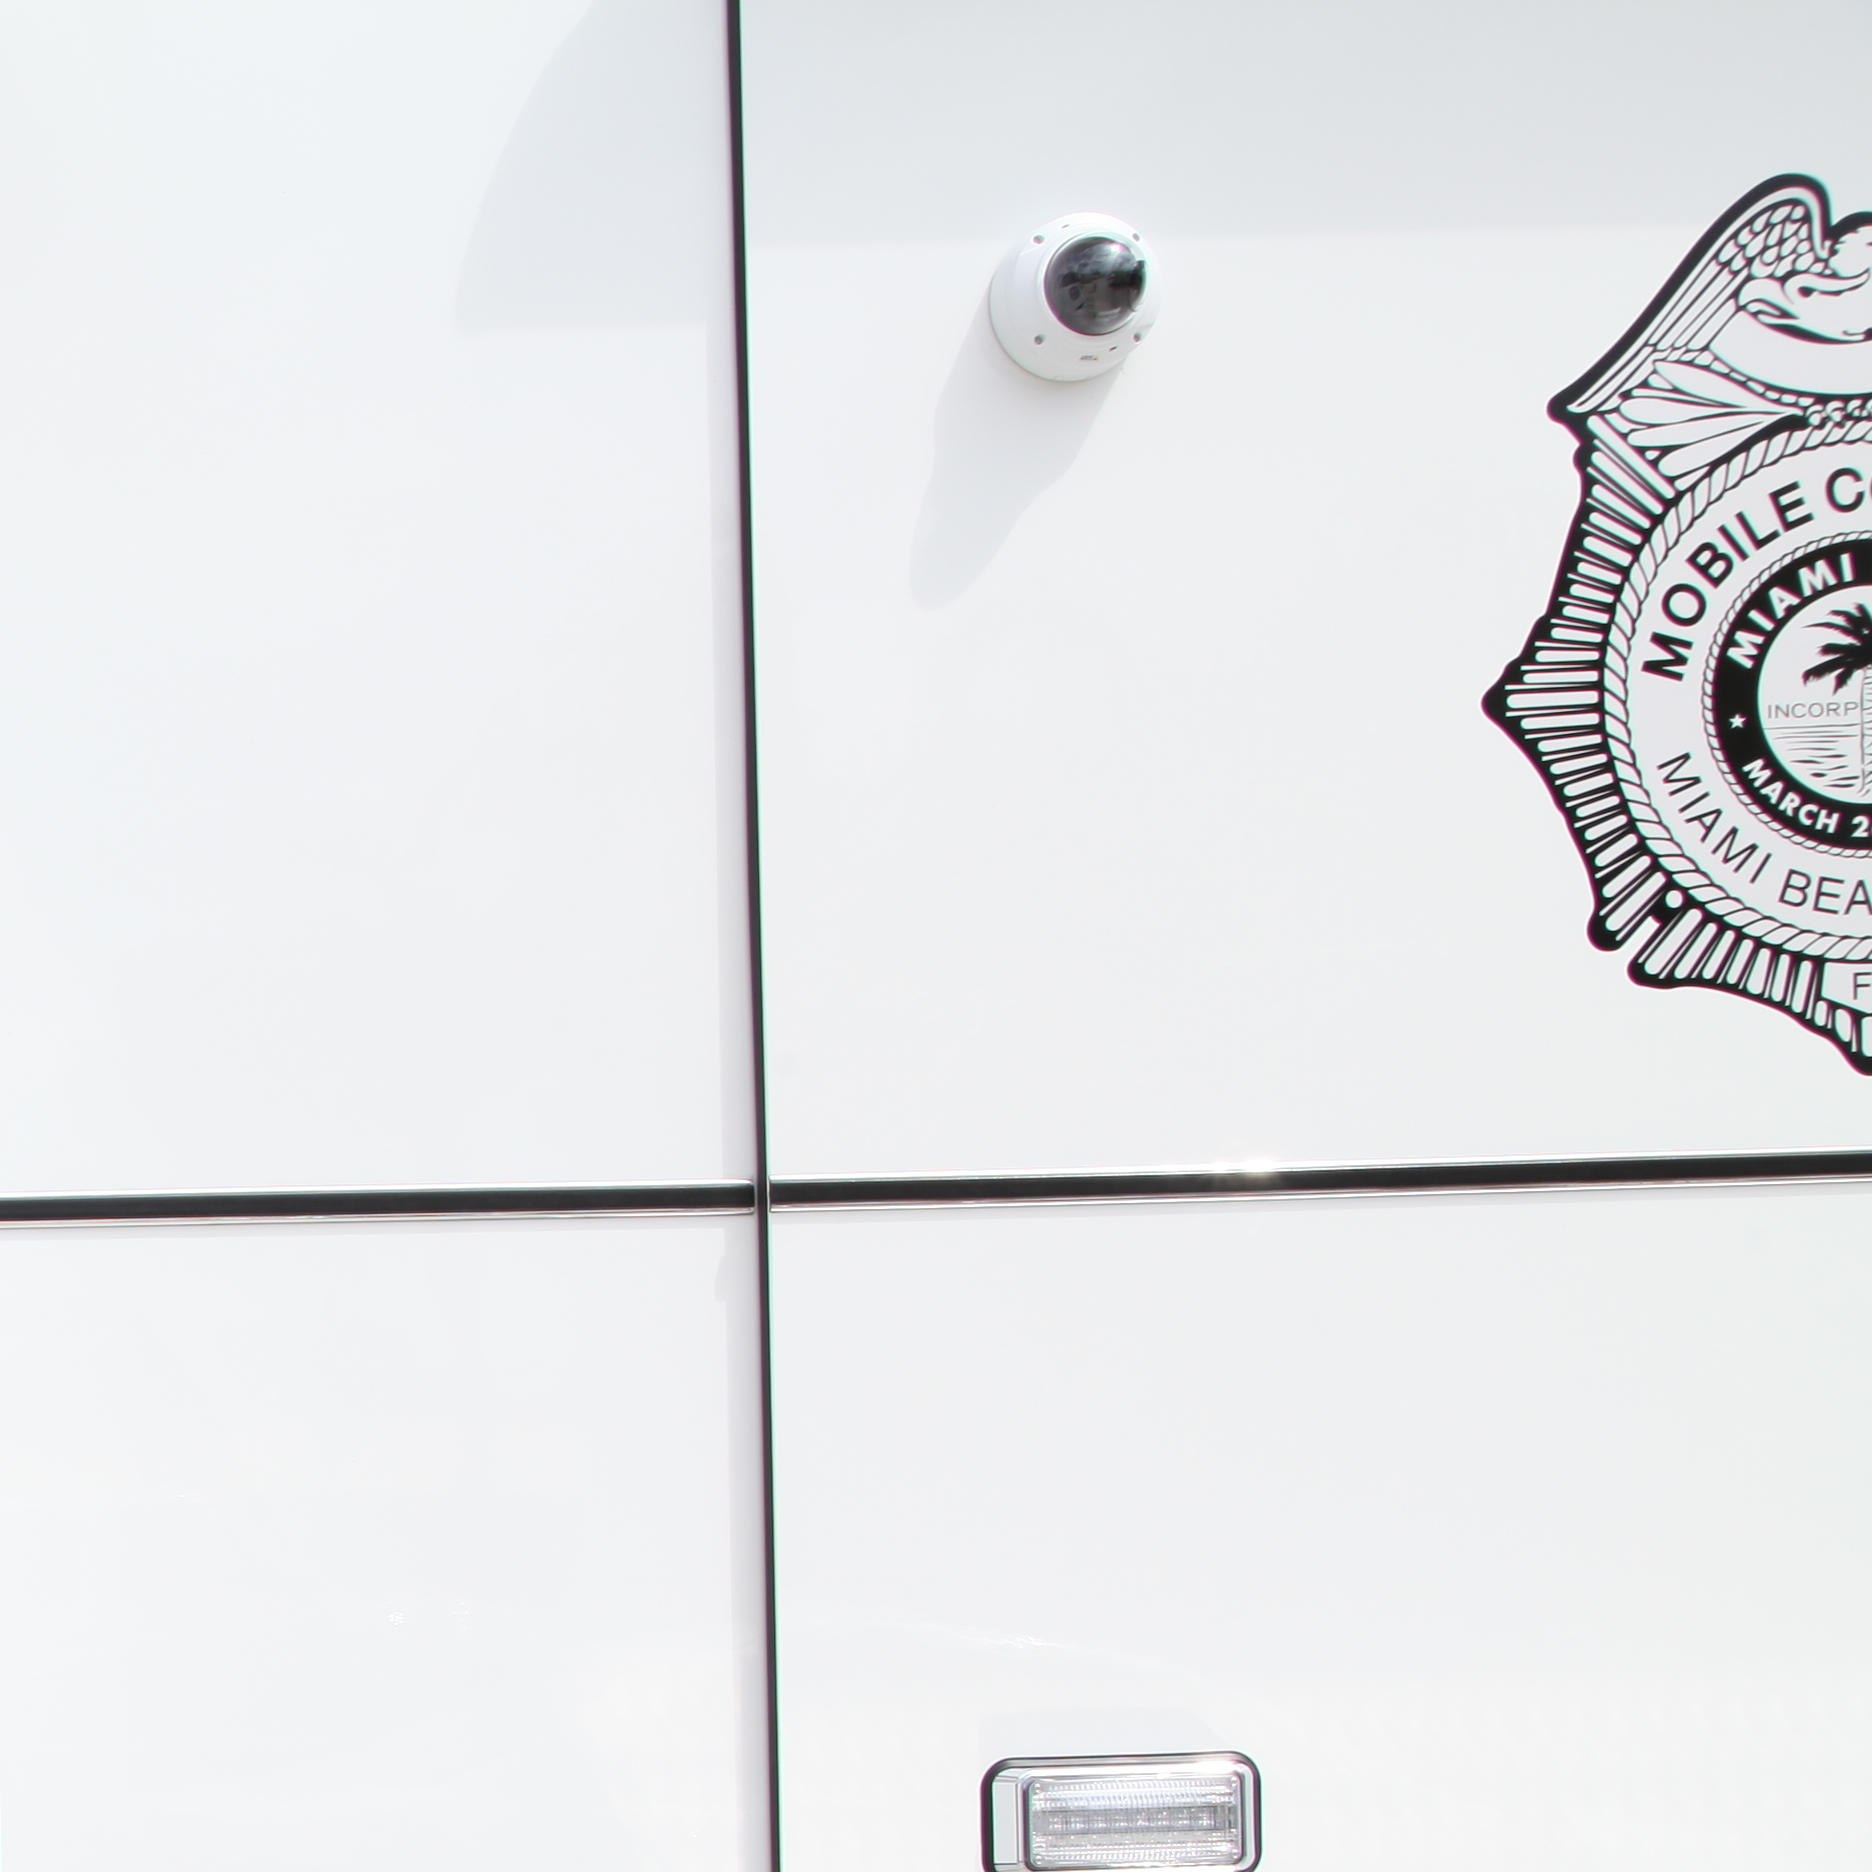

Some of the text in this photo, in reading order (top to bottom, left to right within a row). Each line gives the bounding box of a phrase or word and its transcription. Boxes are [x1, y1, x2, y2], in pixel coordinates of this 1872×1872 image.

[1641, 466, 1872, 682] MOBILE C
[1726, 551, 1856, 669] MIAMI
[1766, 701, 1859, 719] INCORP
[1656, 751, 1872, 916] MIAMI BEA
[1742, 757, 1841, 834] MARCH
